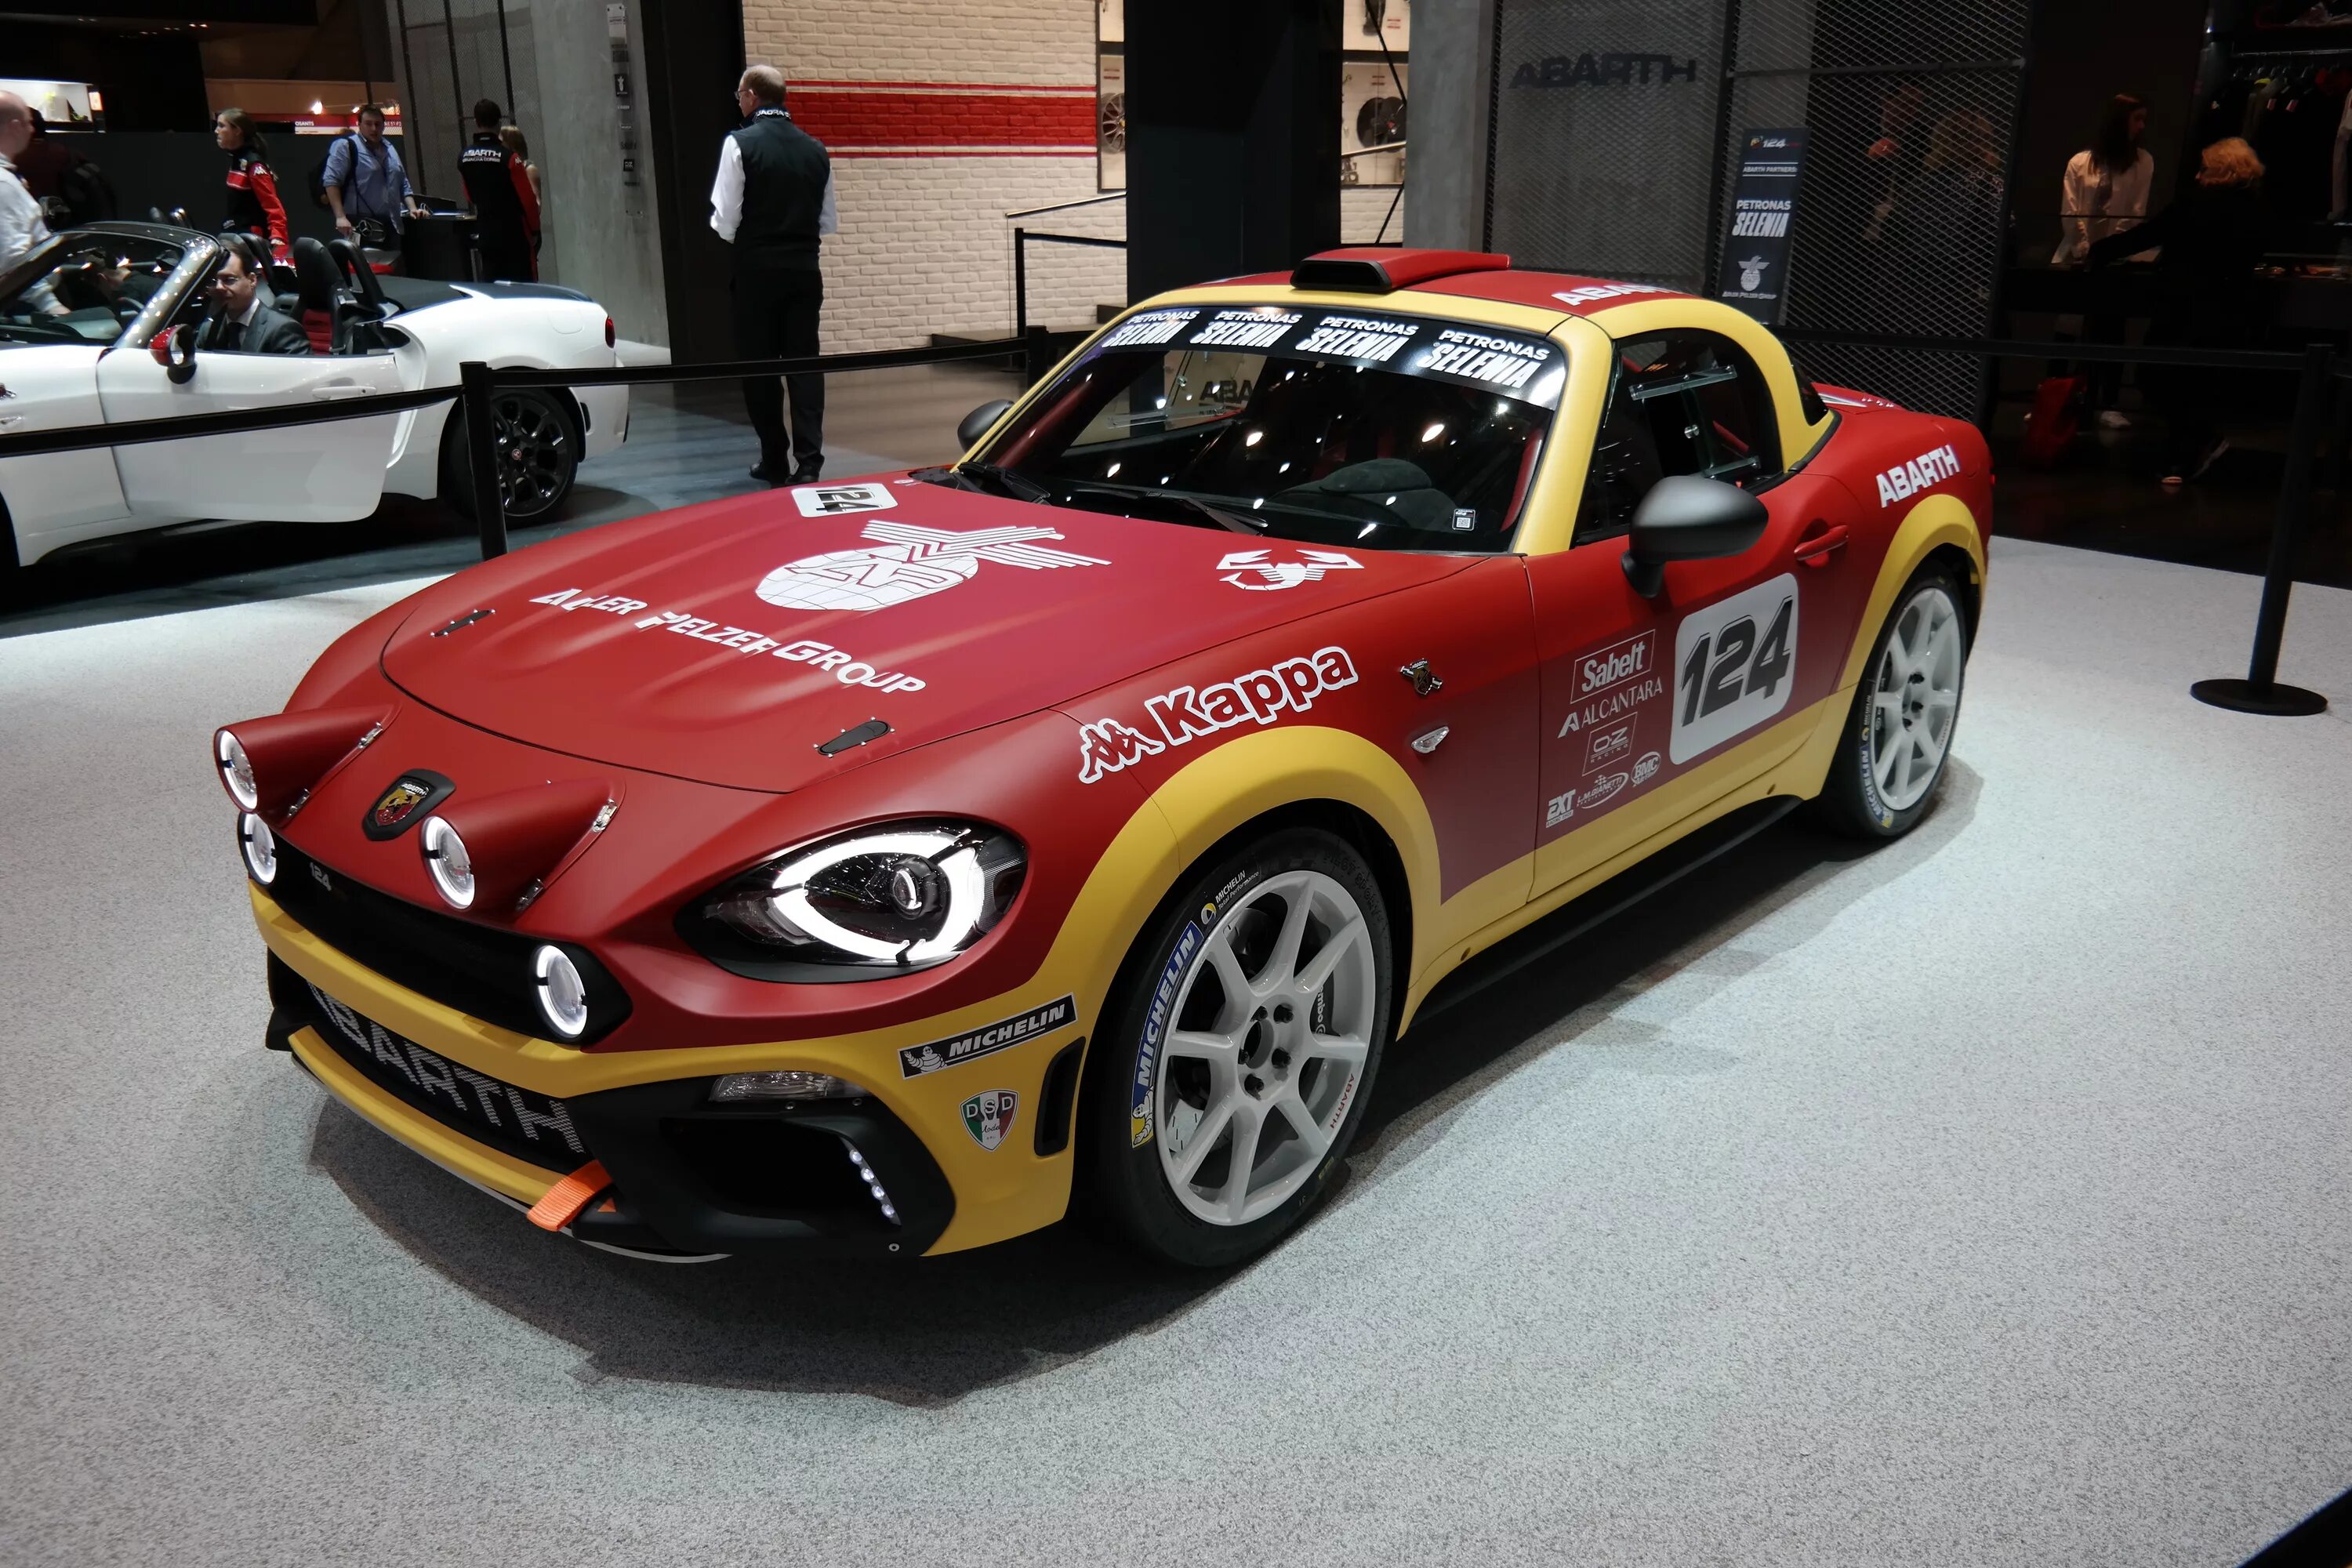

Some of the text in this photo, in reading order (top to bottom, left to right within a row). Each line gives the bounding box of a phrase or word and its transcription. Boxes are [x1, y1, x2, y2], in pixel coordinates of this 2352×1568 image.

[1508, 53, 1697, 89] ABARTH
[463, 149, 502, 158] ABARTH
[1763, 138, 1787, 148] 124
[1736, 200, 1791, 210] PETRONAS
[1732, 212, 1789, 237] SELENIA
[1552, 285, 1686, 306] ABAR
[1127, 310, 1201, 325] PETRONAS
[1214, 311, 1303, 324] PETRONAS
[1319, 317, 1420, 336] PETRONAS
[1102, 320, 1190, 348] SELENIA
[1189, 321, 1293, 348] SELENIA
[1295, 327, 1410, 362] SELENIA
[1438, 330, 1550, 361] PETRONAS
[1417, 343, 1542, 389] SELENIA
[1200, 380, 1253, 404] ABA
[1875, 444, 1960, 509] ABARTH
[815, 487, 883, 513] 124
[772, 640, 927, 694] GROUP
[1581, 641, 1646, 692] Sabelt
[1680, 595, 1794, 728] 124
[1144, 646, 1359, 746] Kappa
[1581, 677, 1663, 728] ALCANTARA
[1634, 757, 1659, 779] BMC
[401, 783, 427, 796] ABARTH
[1547, 789, 1577, 821] EXT
[310, 862, 332, 891] 124
[1215, 869, 1246, 903] MICHELIN
[1218, 871, 1259, 909] Total Performance
[1138, 928, 1195, 1087] MICHELIN
[949, 1004, 1065, 1058] MICHELIN
[1330, 1073, 1355, 1129] ABARTH
